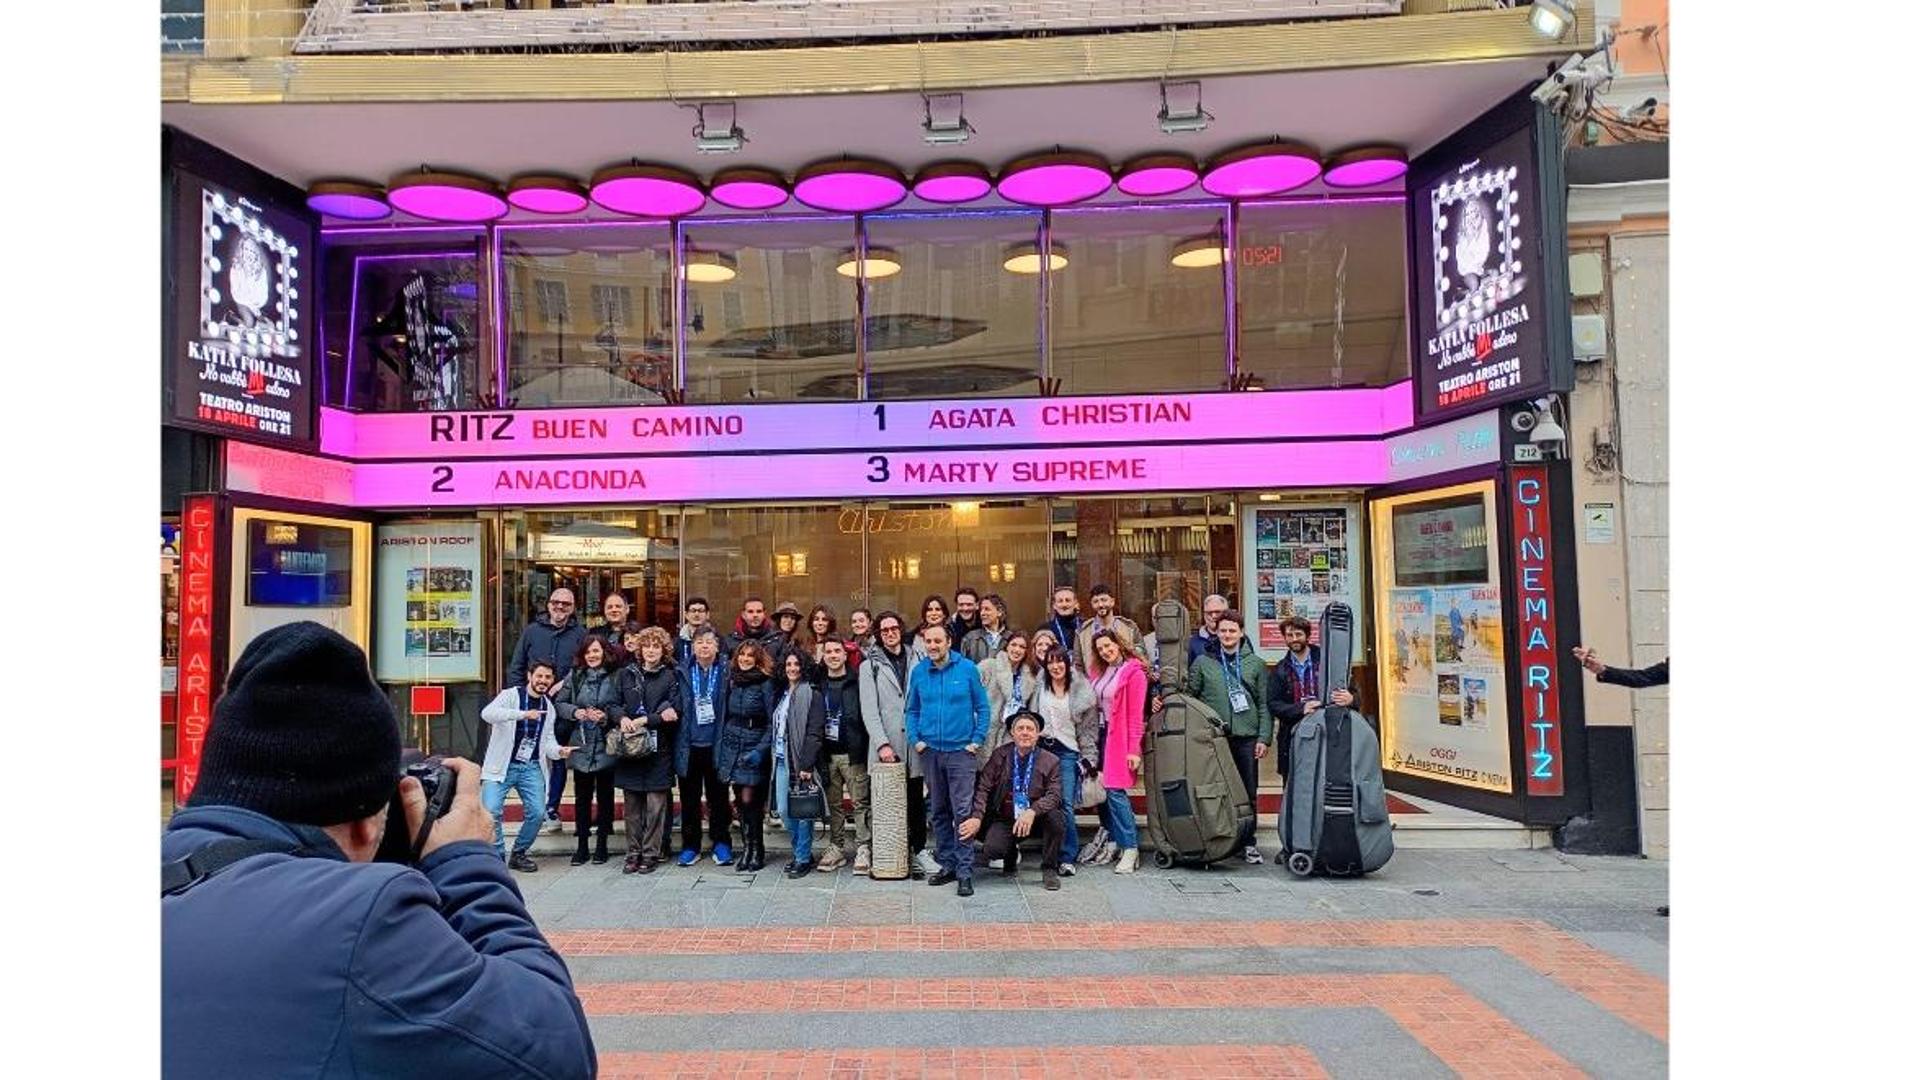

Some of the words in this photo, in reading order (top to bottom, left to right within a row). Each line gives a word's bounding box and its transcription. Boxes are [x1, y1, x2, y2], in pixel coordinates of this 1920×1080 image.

[1428, 329, 1466, 355] KATIA
[1469, 304, 1529, 340] FOLLESA
[188, 340, 237, 368] KATIA
[241, 355, 301, 385] FOLLESA
[1438, 372, 1474, 393] TEATRO
[1475, 357, 1520, 381] ARISTON
[1451, 381, 1486, 402] APRILE
[1488, 377, 1507, 391] ORE
[1509, 370, 1520, 386] 21
[199, 392, 244, 412] TEATRO
[244, 403, 291, 422] ARISTON
[214, 408, 256, 428] APRILE
[259, 419, 278, 433] ORE
[280, 423, 291, 435] 21
[873, 405, 887, 431] 1
[928, 407, 1016, 429] AGATA
[1041, 402, 1191, 426] CHRISTIAN
[430, 415, 515, 442] RITZ
[532, 419, 608, 439] BUEN
[632, 415, 743, 438] CAMINO
[1519, 447, 1538, 458] 212
[431, 465, 455, 493] 2
[494, 469, 646, 490] ANACONDA
[866, 455, 891, 483] 3
[904, 461, 999, 483] MARTY
[1012, 458, 1147, 481] SUPREME
[187, 508, 210, 637] CINEMA
[1518, 479, 1548, 651] CINEMA
[1529, 665, 1554, 778] RITZ
[1429, 748, 1456, 760] OGGI
[1456, 768, 1478, 779] RITZ
